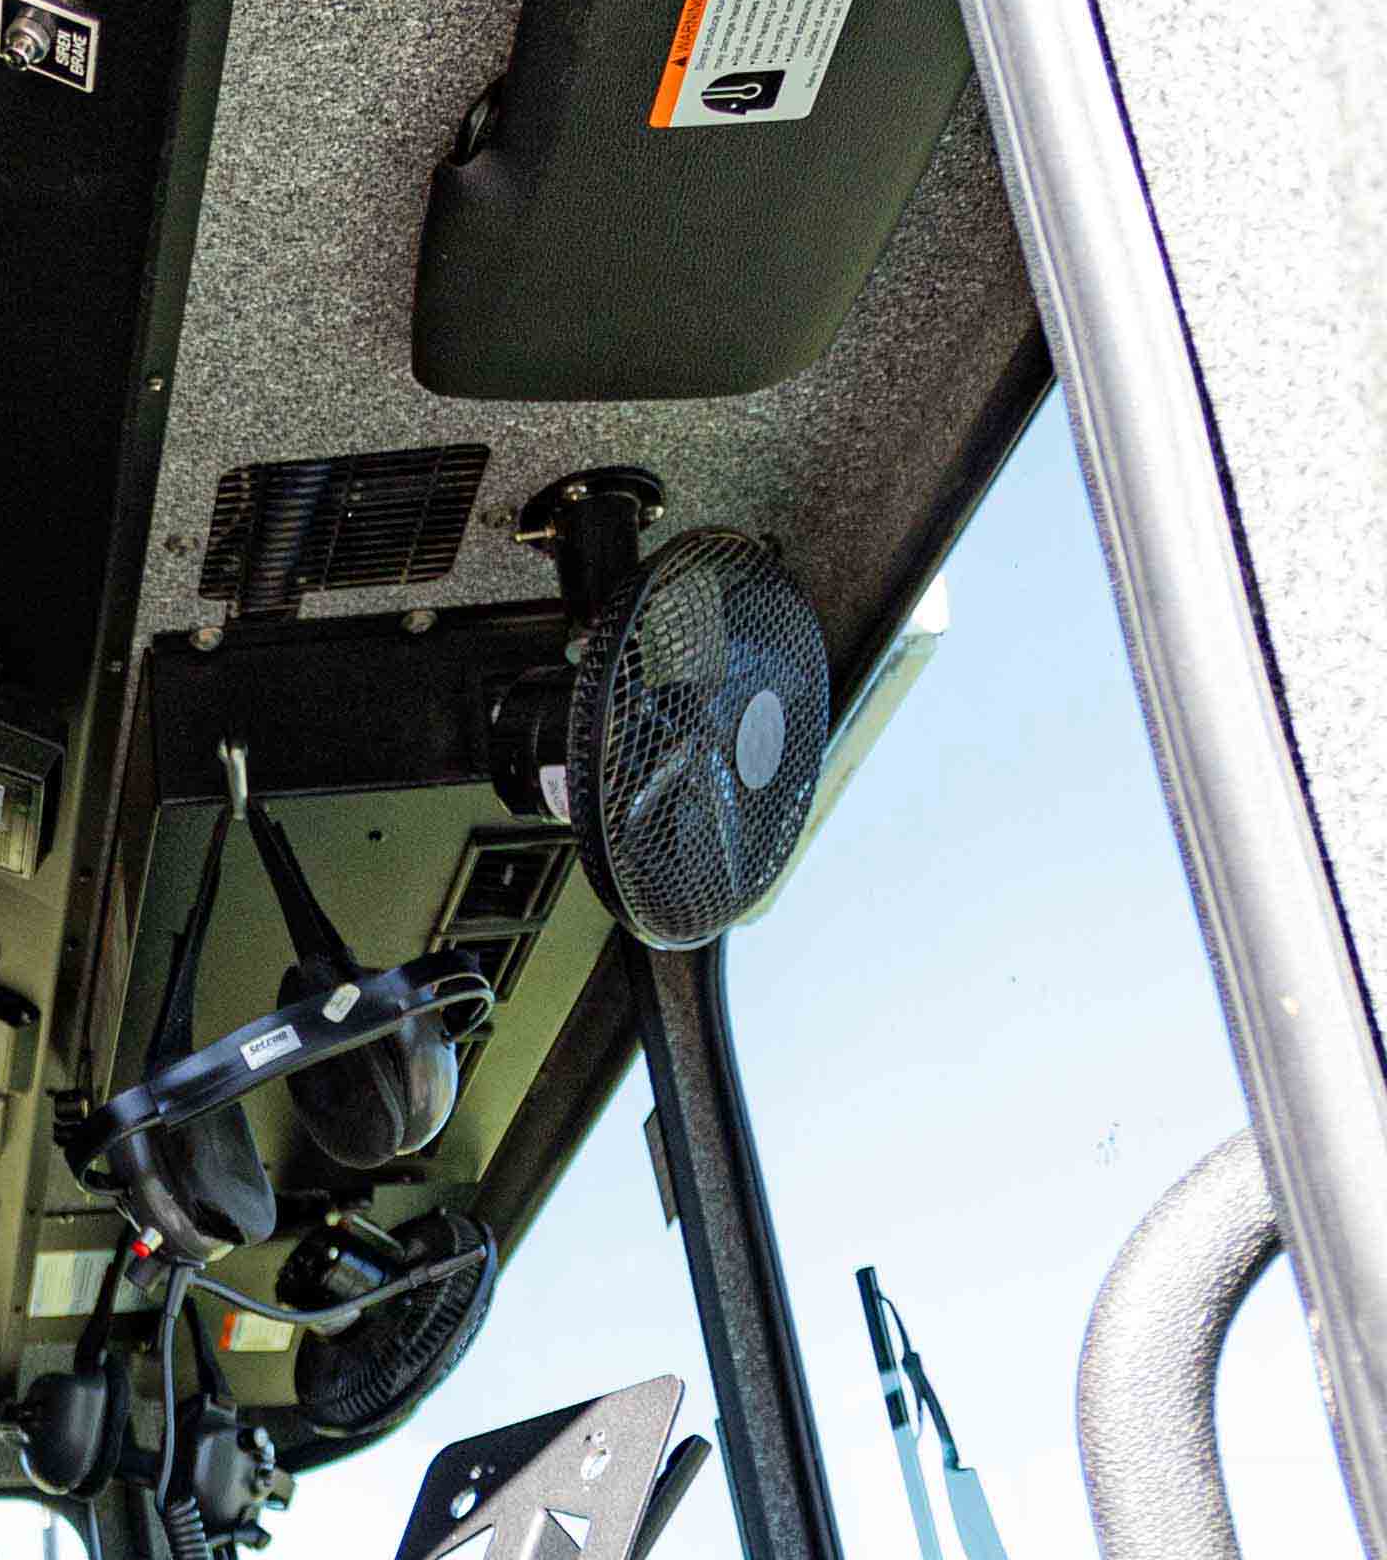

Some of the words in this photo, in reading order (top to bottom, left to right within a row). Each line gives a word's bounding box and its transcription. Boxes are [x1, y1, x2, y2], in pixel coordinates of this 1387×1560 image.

[702, 16, 721, 45] produce
[793, 0, 814, 34] exposure
[55, 30, 71, 66] SIREN
[70, 32, 87, 76] BRAKE
[718, 22, 737, 52] damage
